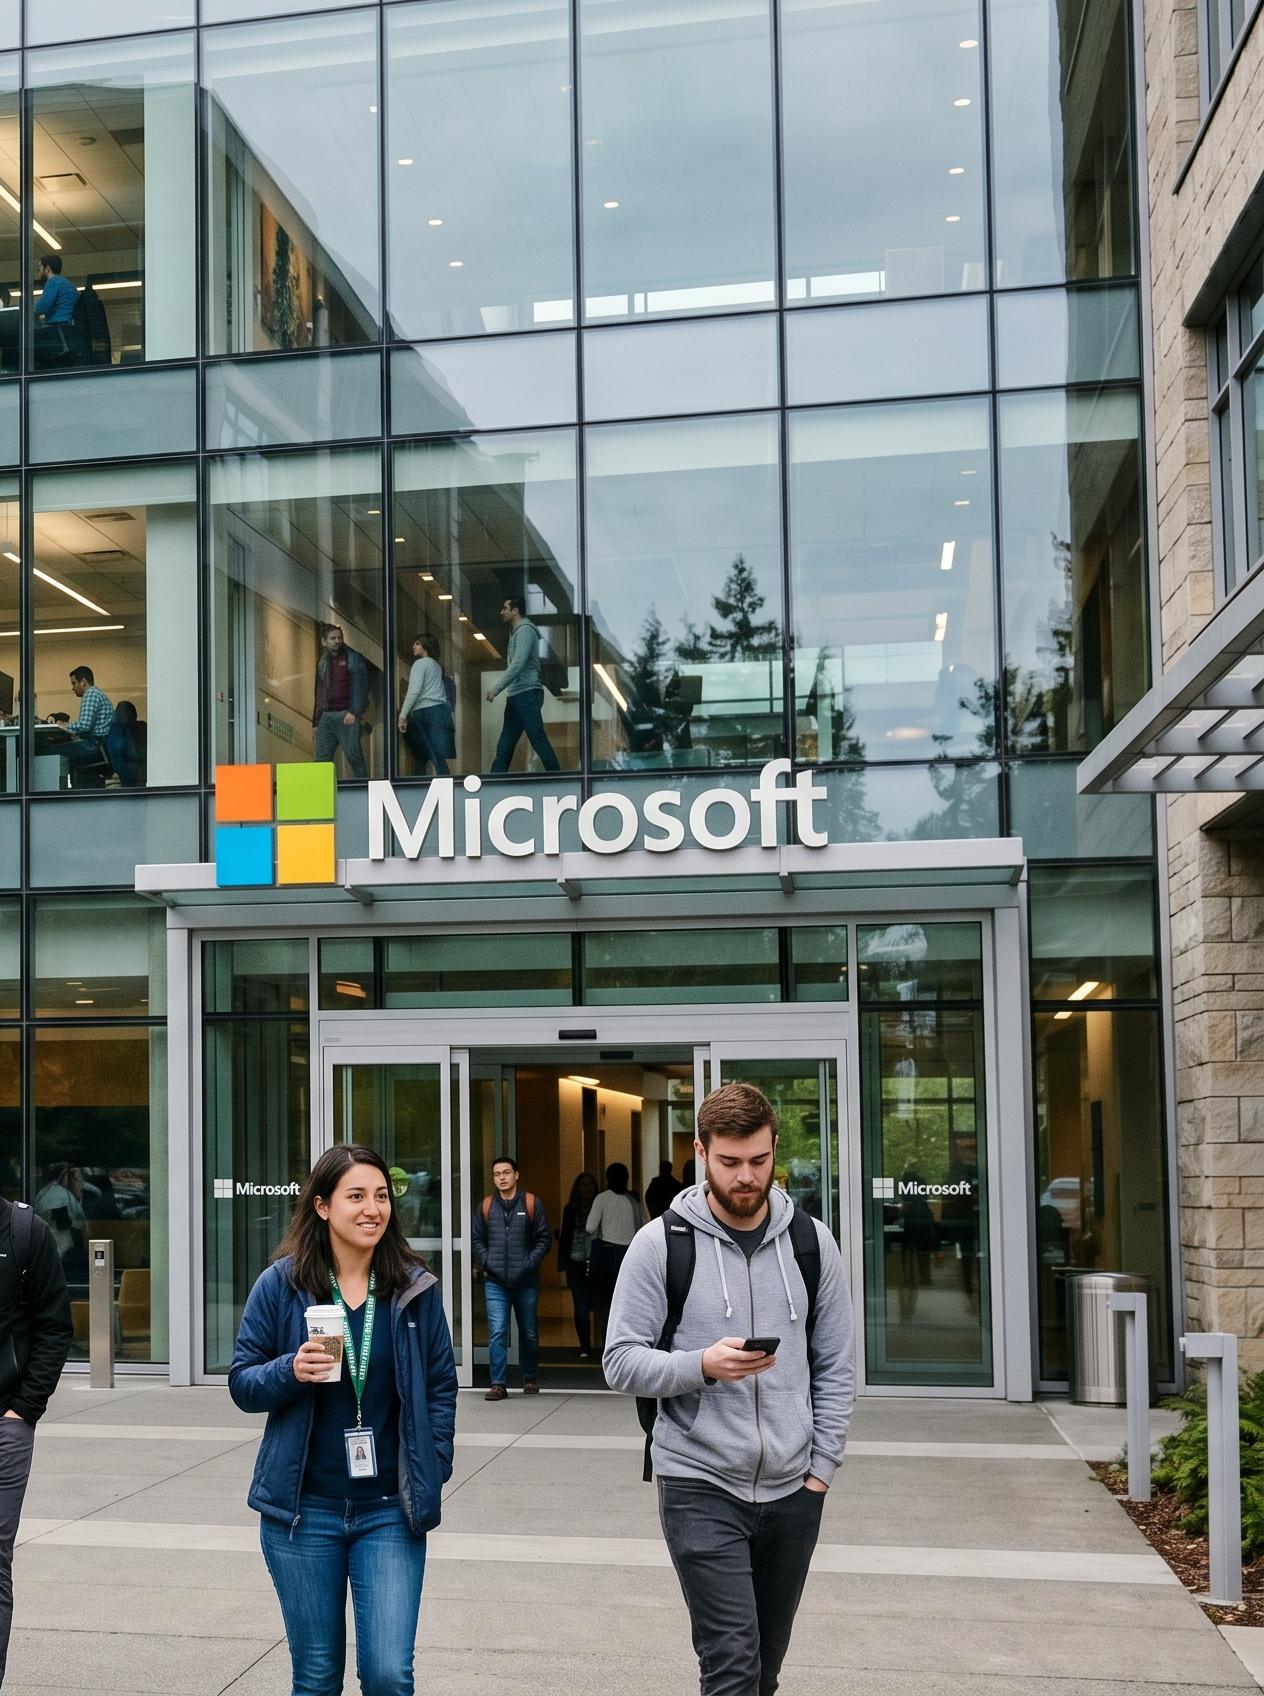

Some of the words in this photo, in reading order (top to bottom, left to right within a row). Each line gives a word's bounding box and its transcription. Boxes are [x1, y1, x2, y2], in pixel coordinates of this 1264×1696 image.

[368, 757, 829, 861] Microsoft
[236, 1181, 301, 1196] Microsoft
[898, 1180, 972, 1196] Microsoft
